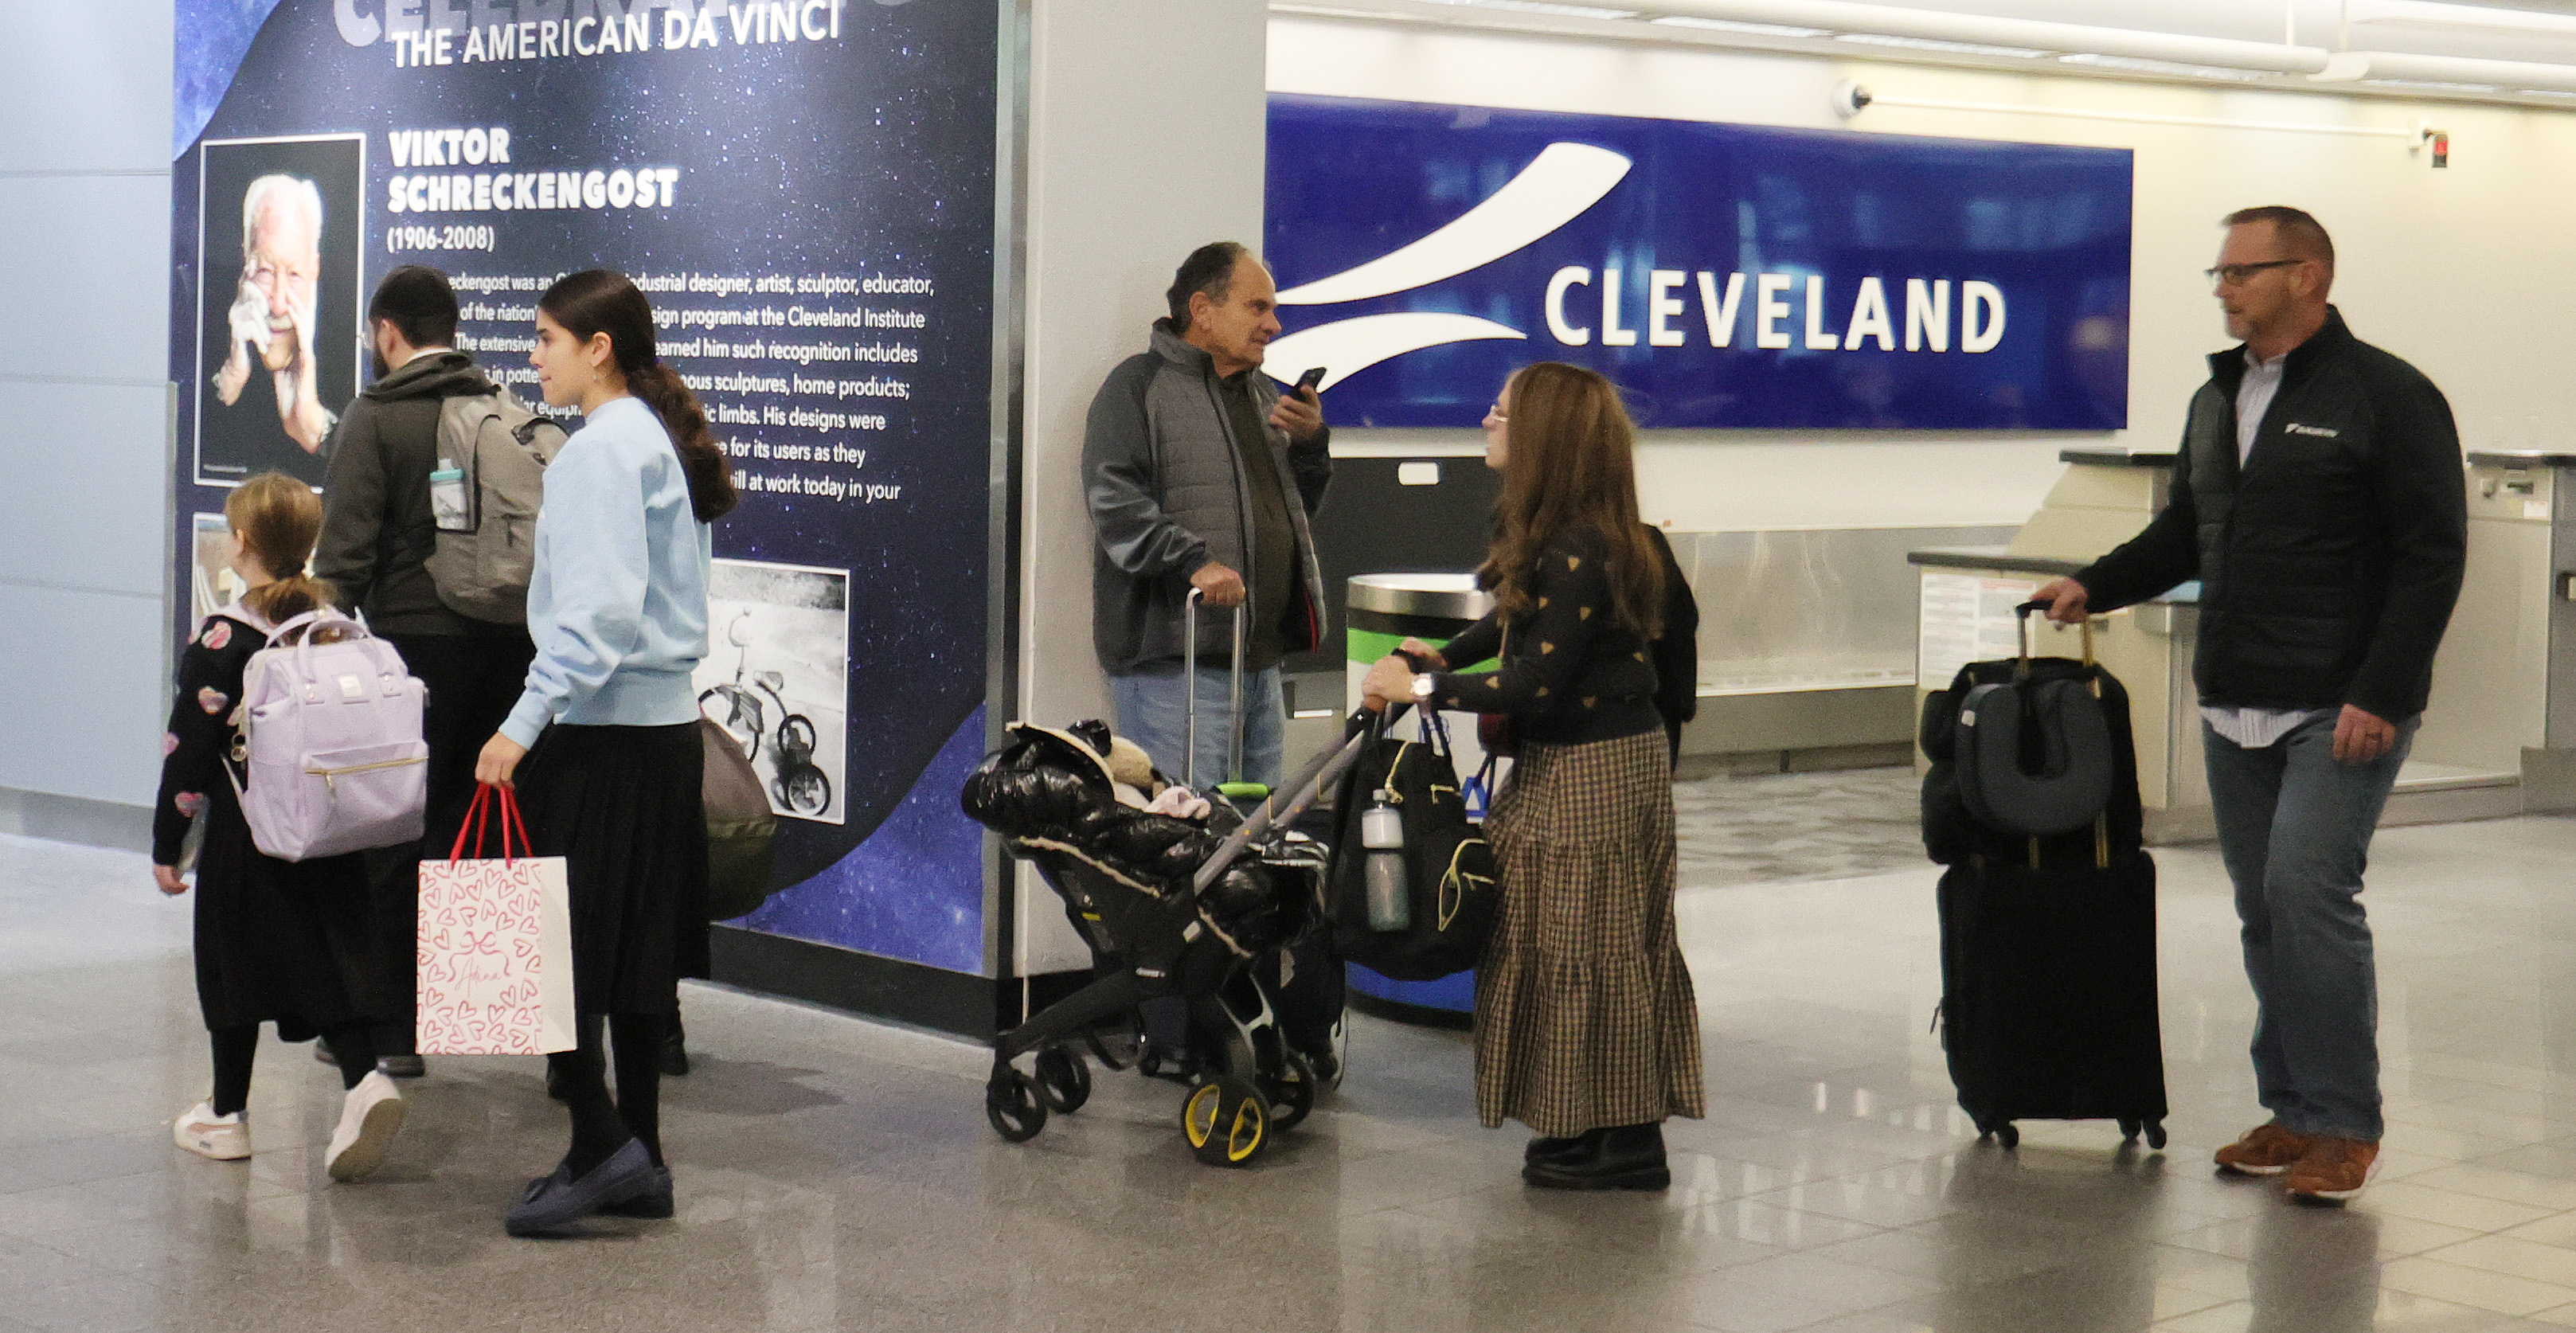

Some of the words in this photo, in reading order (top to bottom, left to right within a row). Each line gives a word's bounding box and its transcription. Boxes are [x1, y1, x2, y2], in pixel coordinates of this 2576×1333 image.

[390, 28, 453, 68] THE
[462, 12, 649, 64] AMERICAN
[663, 7, 718, 50] DA
[729, 0, 839, 45] VINCI
[389, 127, 510, 167] VIKTOR
[387, 167, 679, 213] SCHRECKENGOST
[388, 225, 494, 253] (1906-2008)
[510, 276, 536, 291] was
[537, 276, 553, 291] an
[689, 272, 753, 297] designer,
[756, 272, 795, 295] artist,
[797, 272, 859, 299] sculptor,
[862, 271, 934, 297] educator,
[459, 302, 474, 321] of
[475, 302, 495, 321] the
[681, 309, 741, 330] program
[744, 307, 759, 326] at
[760, 305, 785, 326] the
[788, 305, 861, 327] Cleveland
[865, 307, 926, 328] Institute
[1545, 265, 2007, 354] CLEVELAND
[455, 332, 479, 351] The
[479, 335, 537, 351] extensive
[655, 337, 701, 357] earned
[702, 337, 729, 358] him
[732, 338, 765, 359] such
[768, 341, 851, 366] recognition
[854, 342, 918, 362] includes
[714, 370, 790, 397] sculptures,
[793, 373, 835, 394] home
[718, 402, 760, 424] limbs.
[764, 405, 786, 426] His
[788, 406, 846, 433] designs
[849, 414, 886, 430] were
[730, 436, 751, 457] for
[753, 438, 770, 459] its
[772, 444, 811, 460] users
[814, 445, 831, 462] as
[833, 442, 866, 469] they
[749, 473, 764, 491] at
[765, 473, 801, 494] work
[803, 474, 846, 502] today
[849, 477, 862, 498] in
[866, 483, 901, 504] your
